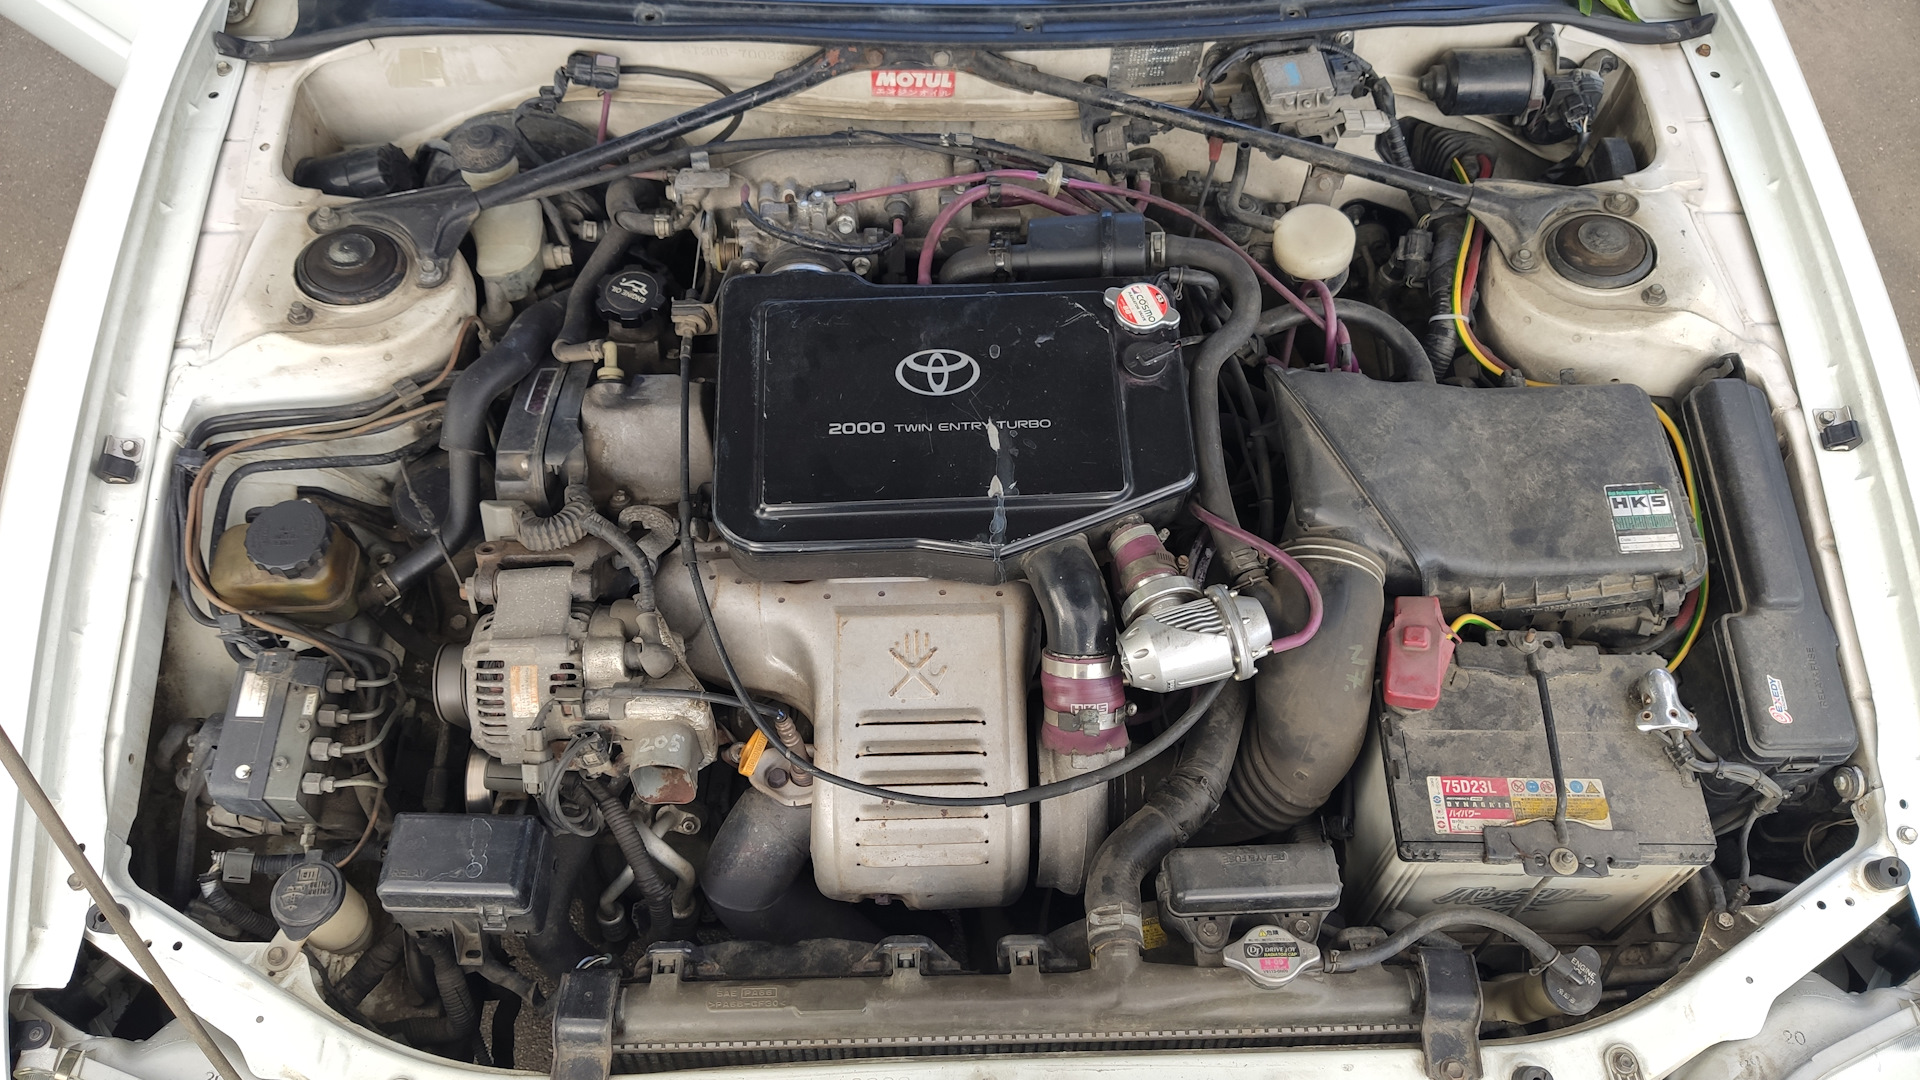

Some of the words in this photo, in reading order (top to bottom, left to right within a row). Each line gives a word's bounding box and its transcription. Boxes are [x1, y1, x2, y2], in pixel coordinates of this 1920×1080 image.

[875, 71, 953, 88] MOTUL
[621, 289, 647, 304] ENGINE
[1136, 294, 1156, 323] COSMO
[828, 421, 886, 435] 2000
[894, 423, 933, 433] TWIN
[938, 420, 991, 432] ENTRY
[996, 418, 1052, 430] TURBO
[1611, 495, 1667, 509] HKS
[1768, 676, 1784, 713] EXEDY
[639, 733, 685, 753] 205
[1442, 779, 1497, 794] 75D23L
[1446, 801, 1511, 809] DYNAGRID
[1449, 809, 1481, 818] ハイパワー
[391, 868, 429, 879] RELAY
[1570, 956, 1597, 980] ENGINE
[716, 990, 737, 998] SAE
